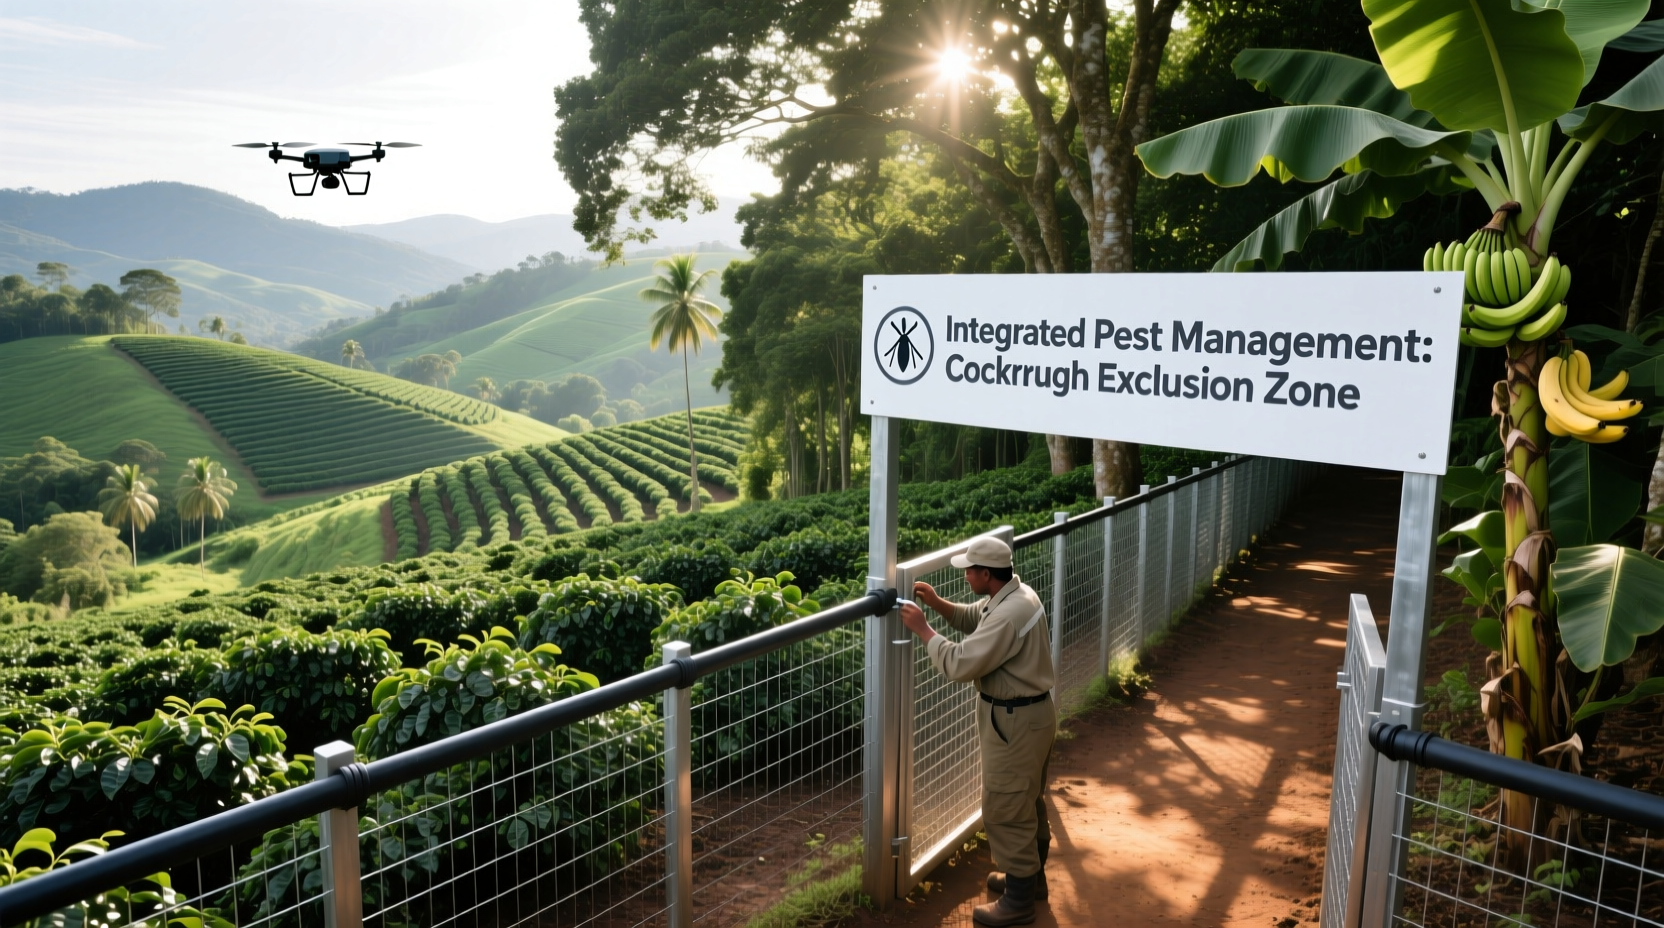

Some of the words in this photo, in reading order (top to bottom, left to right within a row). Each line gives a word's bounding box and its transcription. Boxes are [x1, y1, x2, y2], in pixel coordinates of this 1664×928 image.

[945, 314, 1086, 351] Integrated
[1094, 318, 1164, 353] Pest
[1171, 320, 1433, 366] Management:
[945, 353, 1090, 399] Cockrrugh
[1098, 362, 1254, 404] Exclusion
[1263, 370, 1361, 412] Zone
